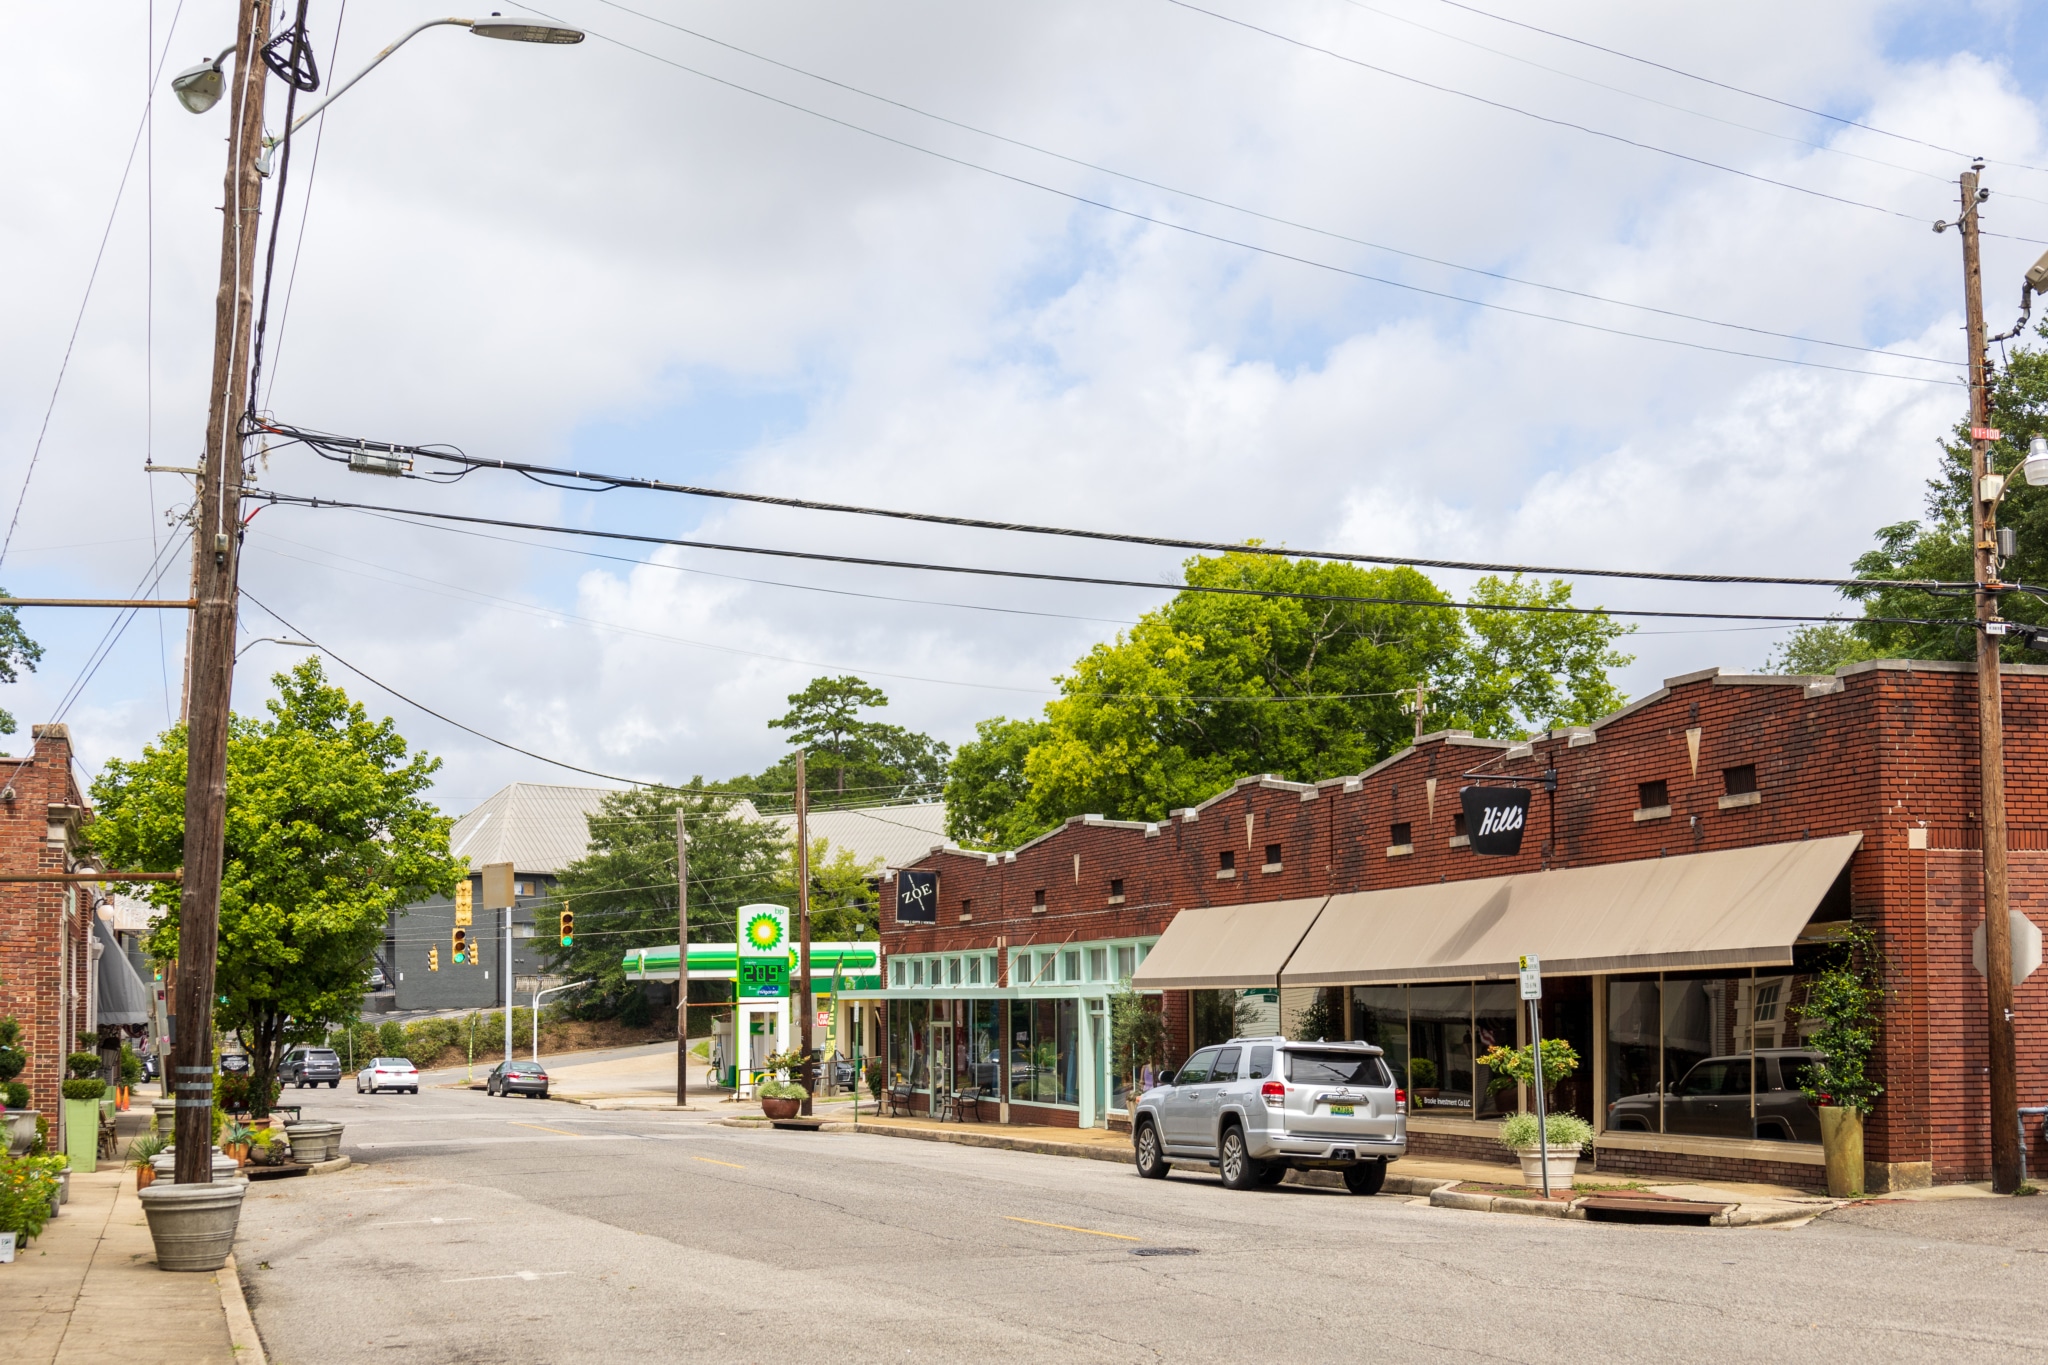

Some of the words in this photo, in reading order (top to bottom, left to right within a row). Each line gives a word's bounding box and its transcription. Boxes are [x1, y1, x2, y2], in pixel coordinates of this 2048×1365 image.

[1974, 428, 2000, 440] 11-100
[1478, 805, 1523, 836] Hill's
[901, 883, 932, 904] ZOE
[1437, 1098, 1458, 1106] Investment
